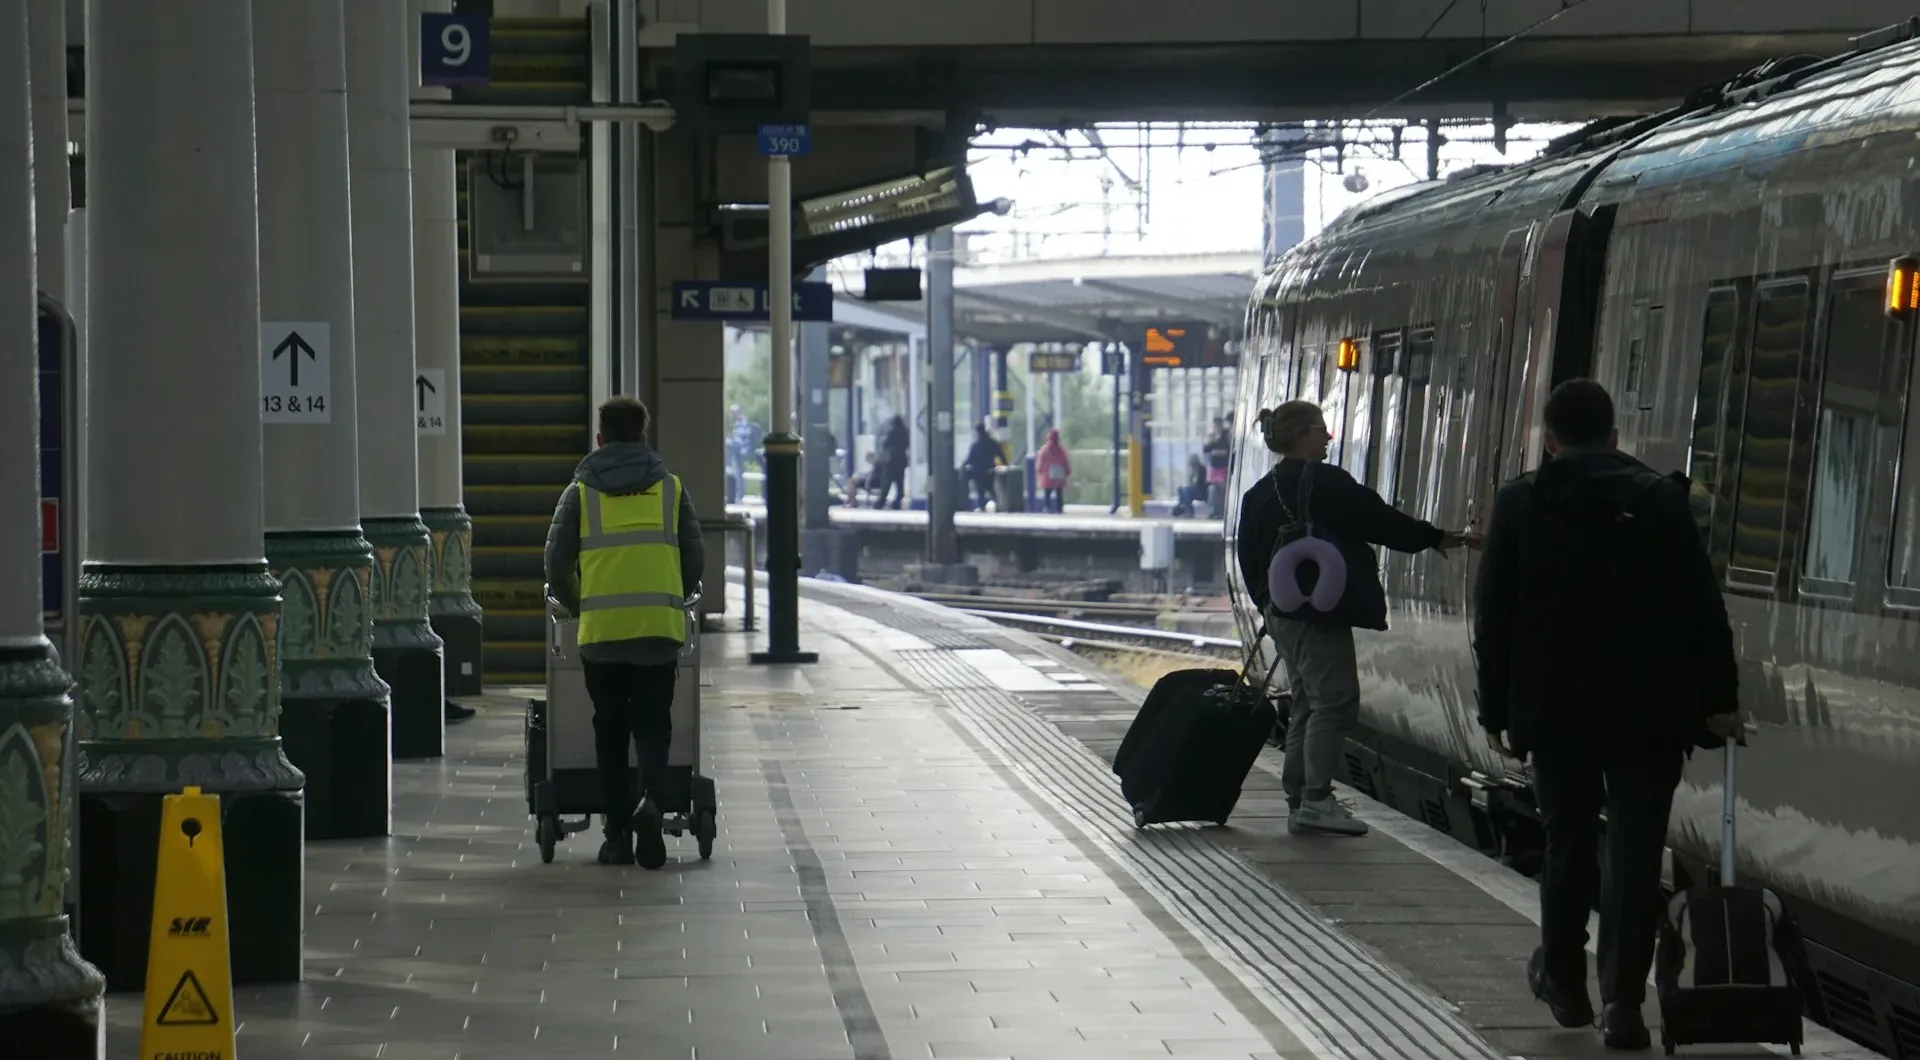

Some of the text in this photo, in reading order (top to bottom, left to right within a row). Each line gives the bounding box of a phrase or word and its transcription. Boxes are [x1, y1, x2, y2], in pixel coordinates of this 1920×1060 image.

[440, 23, 471, 67] 9
[769, 137, 800, 153] 390
[763, 290, 802, 310] Lt
[263, 395, 325, 412] 13 & 14
[417, 416, 442, 428] & 14
[168, 916, 212, 932] SIR
